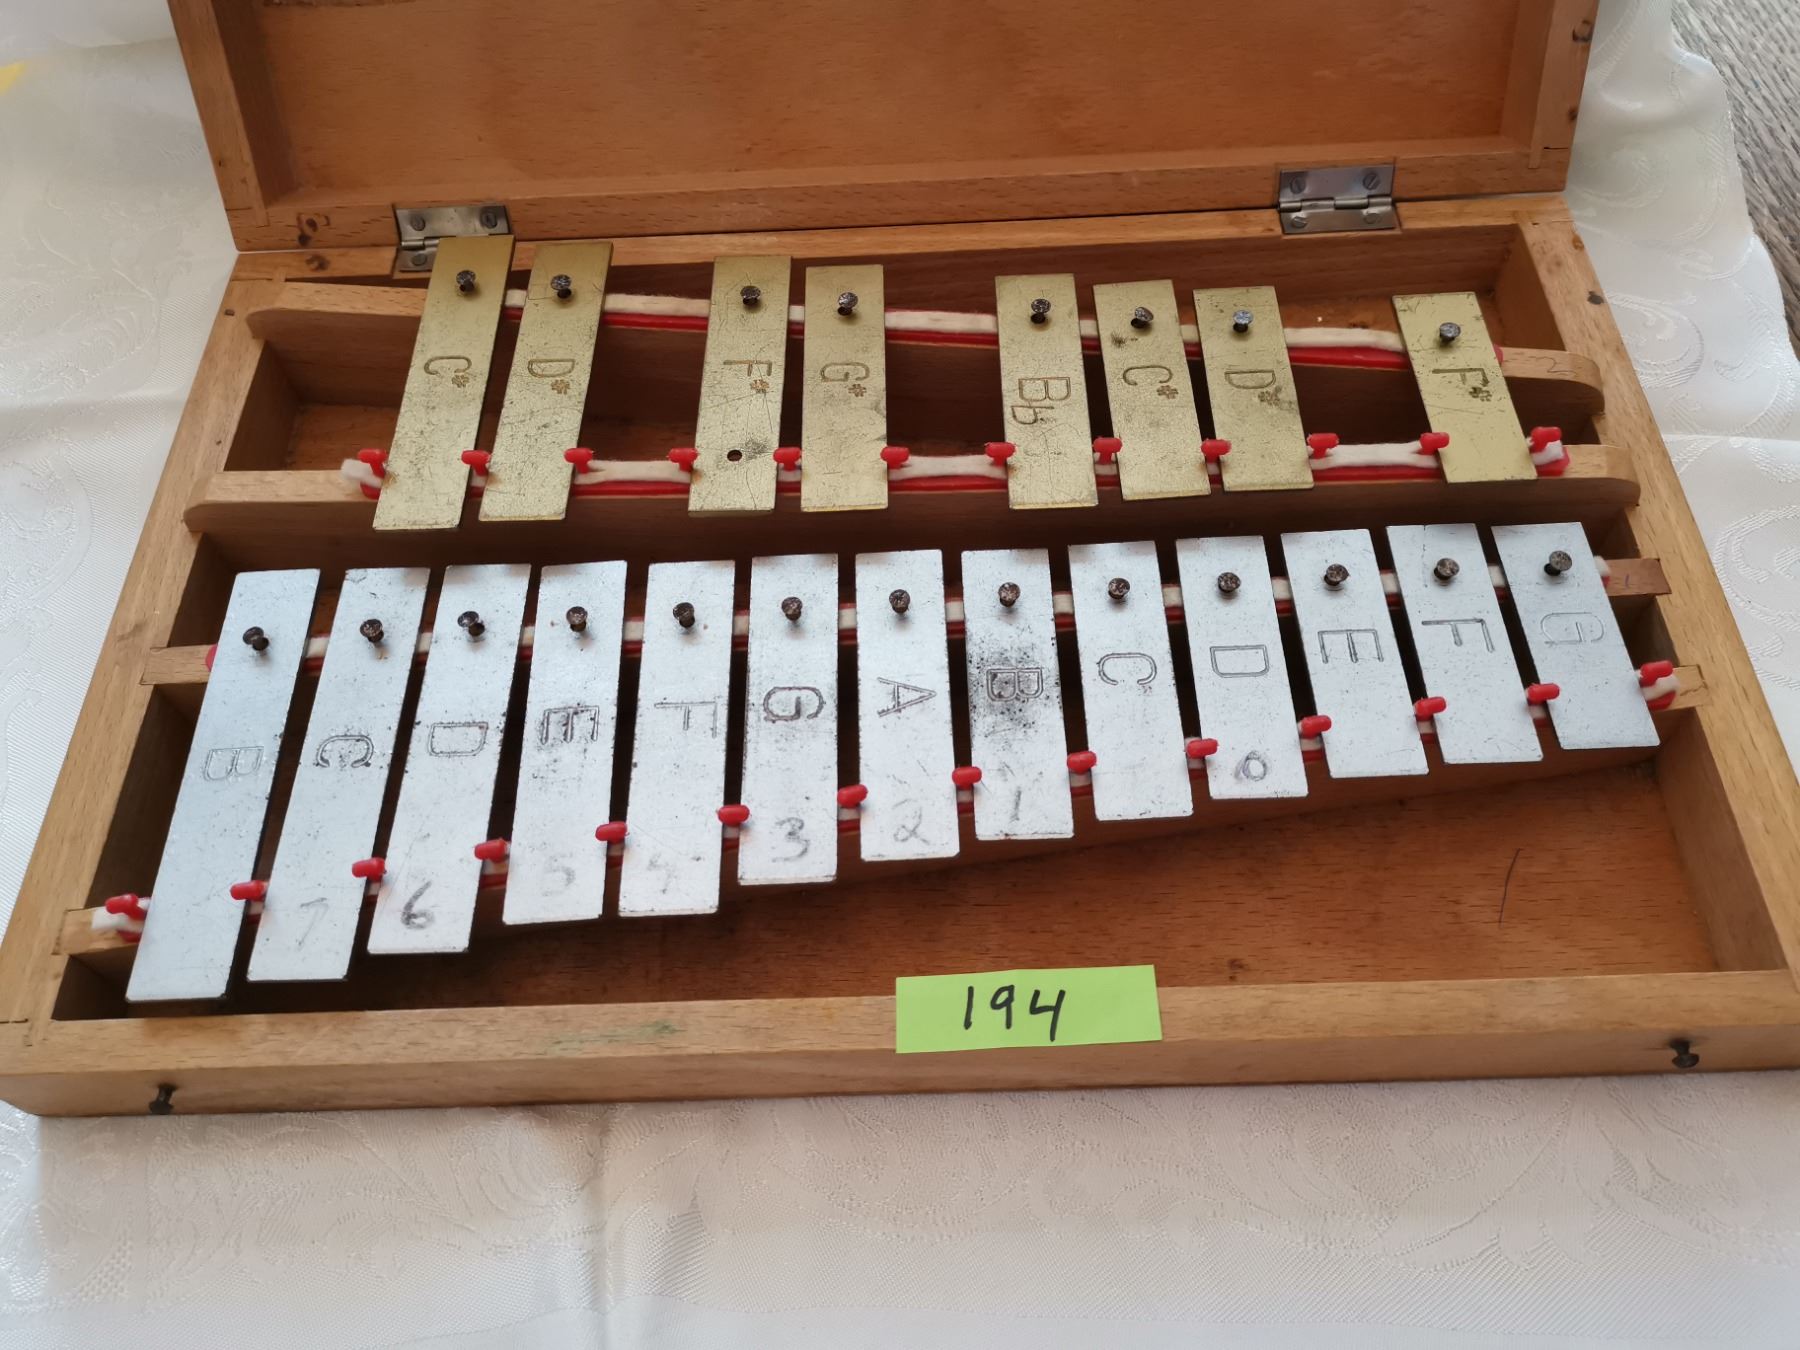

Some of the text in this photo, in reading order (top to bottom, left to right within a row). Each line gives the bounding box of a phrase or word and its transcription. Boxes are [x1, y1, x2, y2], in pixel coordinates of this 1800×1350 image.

[1317, 628, 1384, 663] E
[1421, 617, 1495, 652] F
[1540, 611, 1604, 645] G
[1099, 652, 1157, 686] C
[1210, 644, 1269, 678] D
[876, 676, 937, 718] A
[986, 666, 1044, 701] B
[654, 700, 718, 738] F
[763, 686, 825, 722] G
[427, 721, 489, 757] D
[540, 704, 600, 744] E
[203, 746, 264, 781] B
[316, 734, 374, 768] C
[772, 815, 811, 863] 3
[401, 881, 435, 929] 6
[964, 984, 1066, 1042] 194
